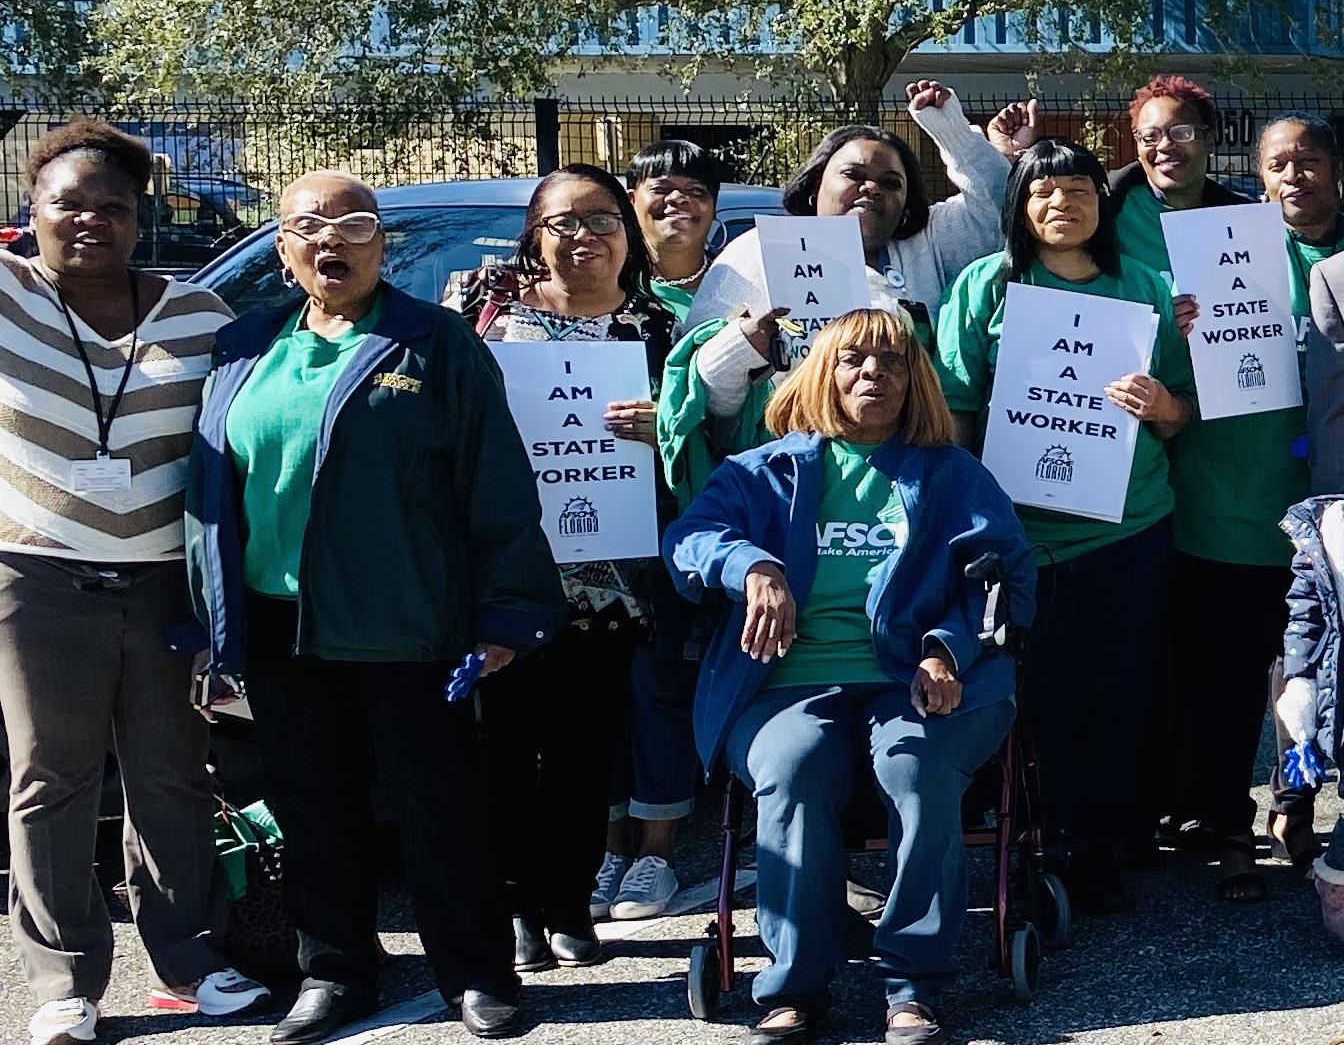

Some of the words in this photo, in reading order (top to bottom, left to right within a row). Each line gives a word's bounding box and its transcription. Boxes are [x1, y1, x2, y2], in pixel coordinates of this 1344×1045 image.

[1226, 226, 1234, 240] I
[800, 237, 807, 252] I
[1218, 250, 1251, 266] AM
[793, 263, 824, 279] AM
[1231, 276, 1247, 291] A
[805, 291, 820, 305] A
[1212, 299, 1269, 318] STATE
[791, 317, 832, 332] STAT
[1073, 313, 1081, 328] I
[1201, 323, 1285, 345] WORKER
[1051, 338, 1094, 357] AM
[564, 360, 572, 374] I
[1058, 365, 1078, 381] A
[547, 386, 593, 401] AM
[1027, 386, 1104, 411] STATE
[561, 413, 584, 428] A
[1006, 407, 1117, 440] WORKER
[531, 438, 616, 457] STATE
[816, 522, 902, 548] FSC
